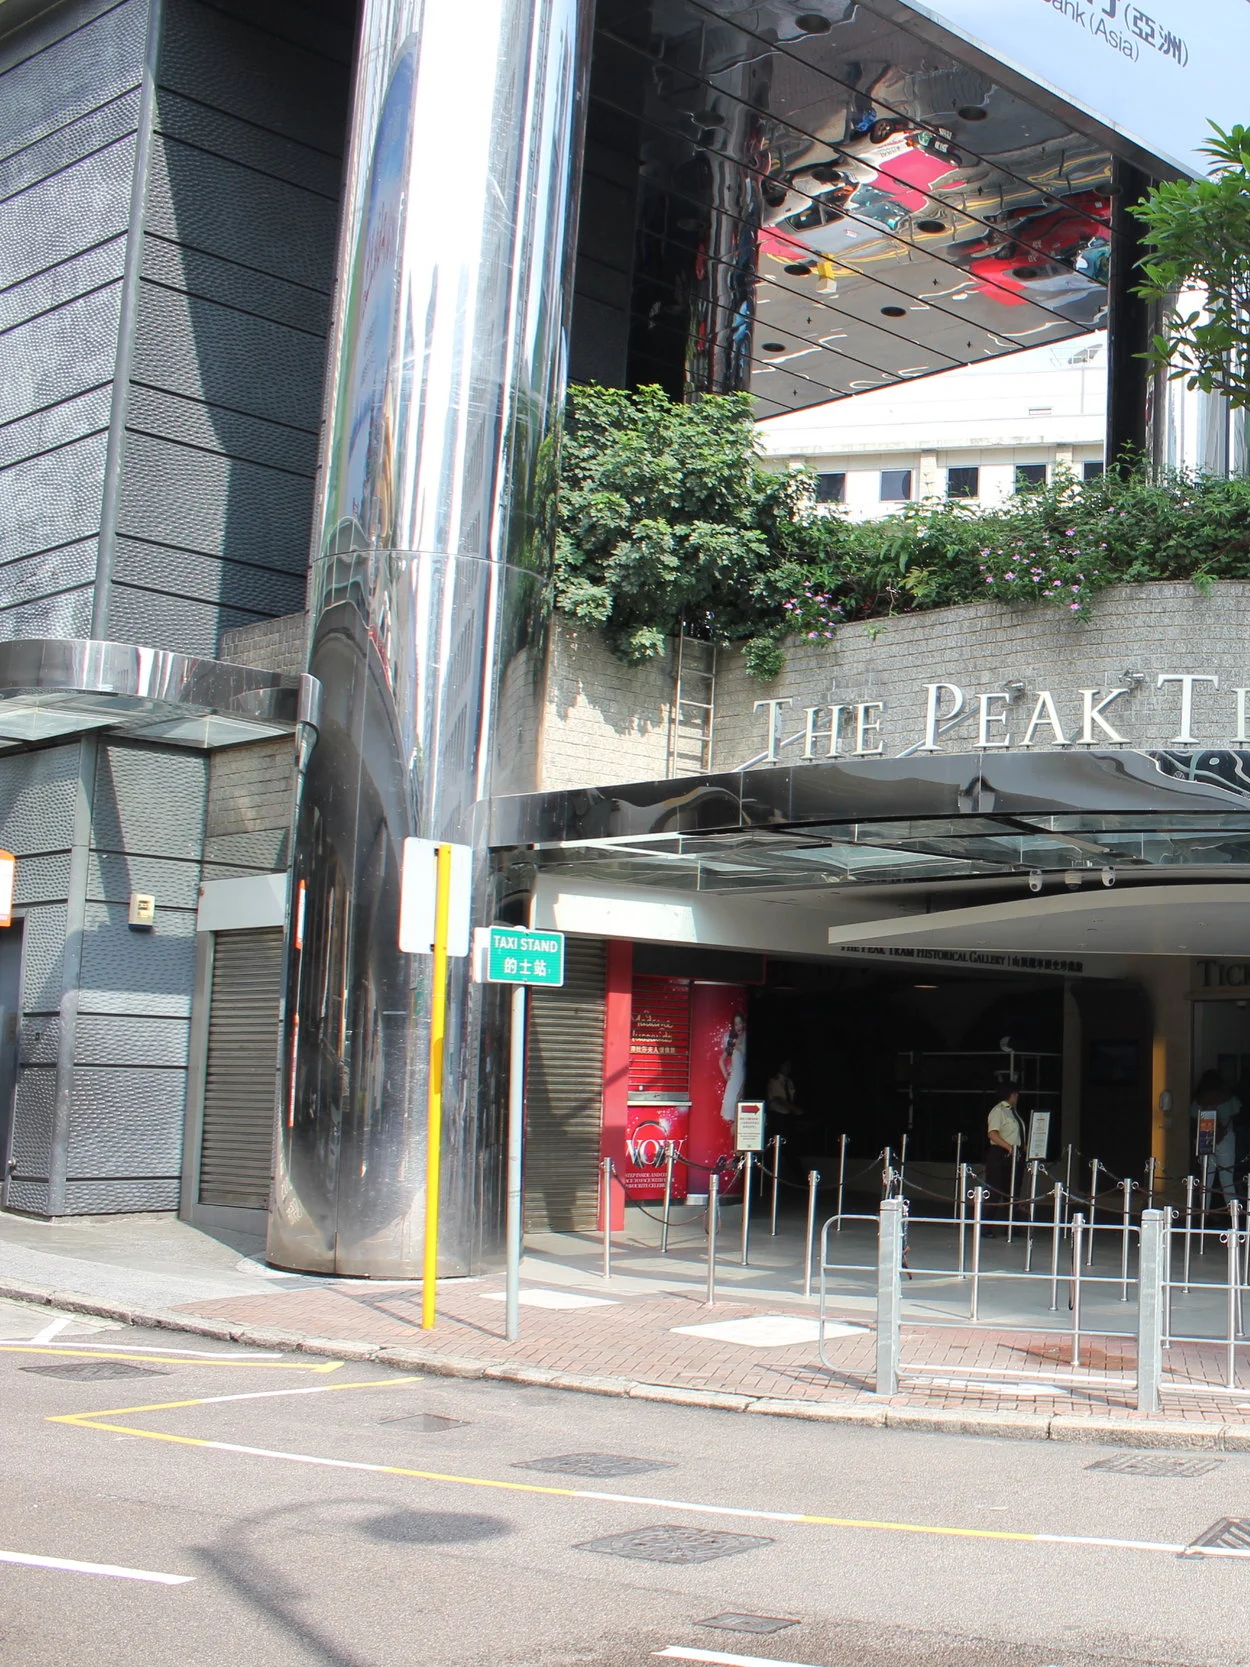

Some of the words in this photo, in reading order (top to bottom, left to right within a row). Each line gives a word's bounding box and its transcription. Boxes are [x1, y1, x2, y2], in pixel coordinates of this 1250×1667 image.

[1043, 0, 1086, 28] ank
[1089, 12, 1140, 63] (Asia)
[752, 698, 888, 763] THE
[919, 683, 1133, 752] PEAK
[493, 935, 518, 950] TAXI
[520, 938, 558, 953] STAND
[504, 957, 547, 977] 的士站
[969, 951, 1006, 965] GALLERY
